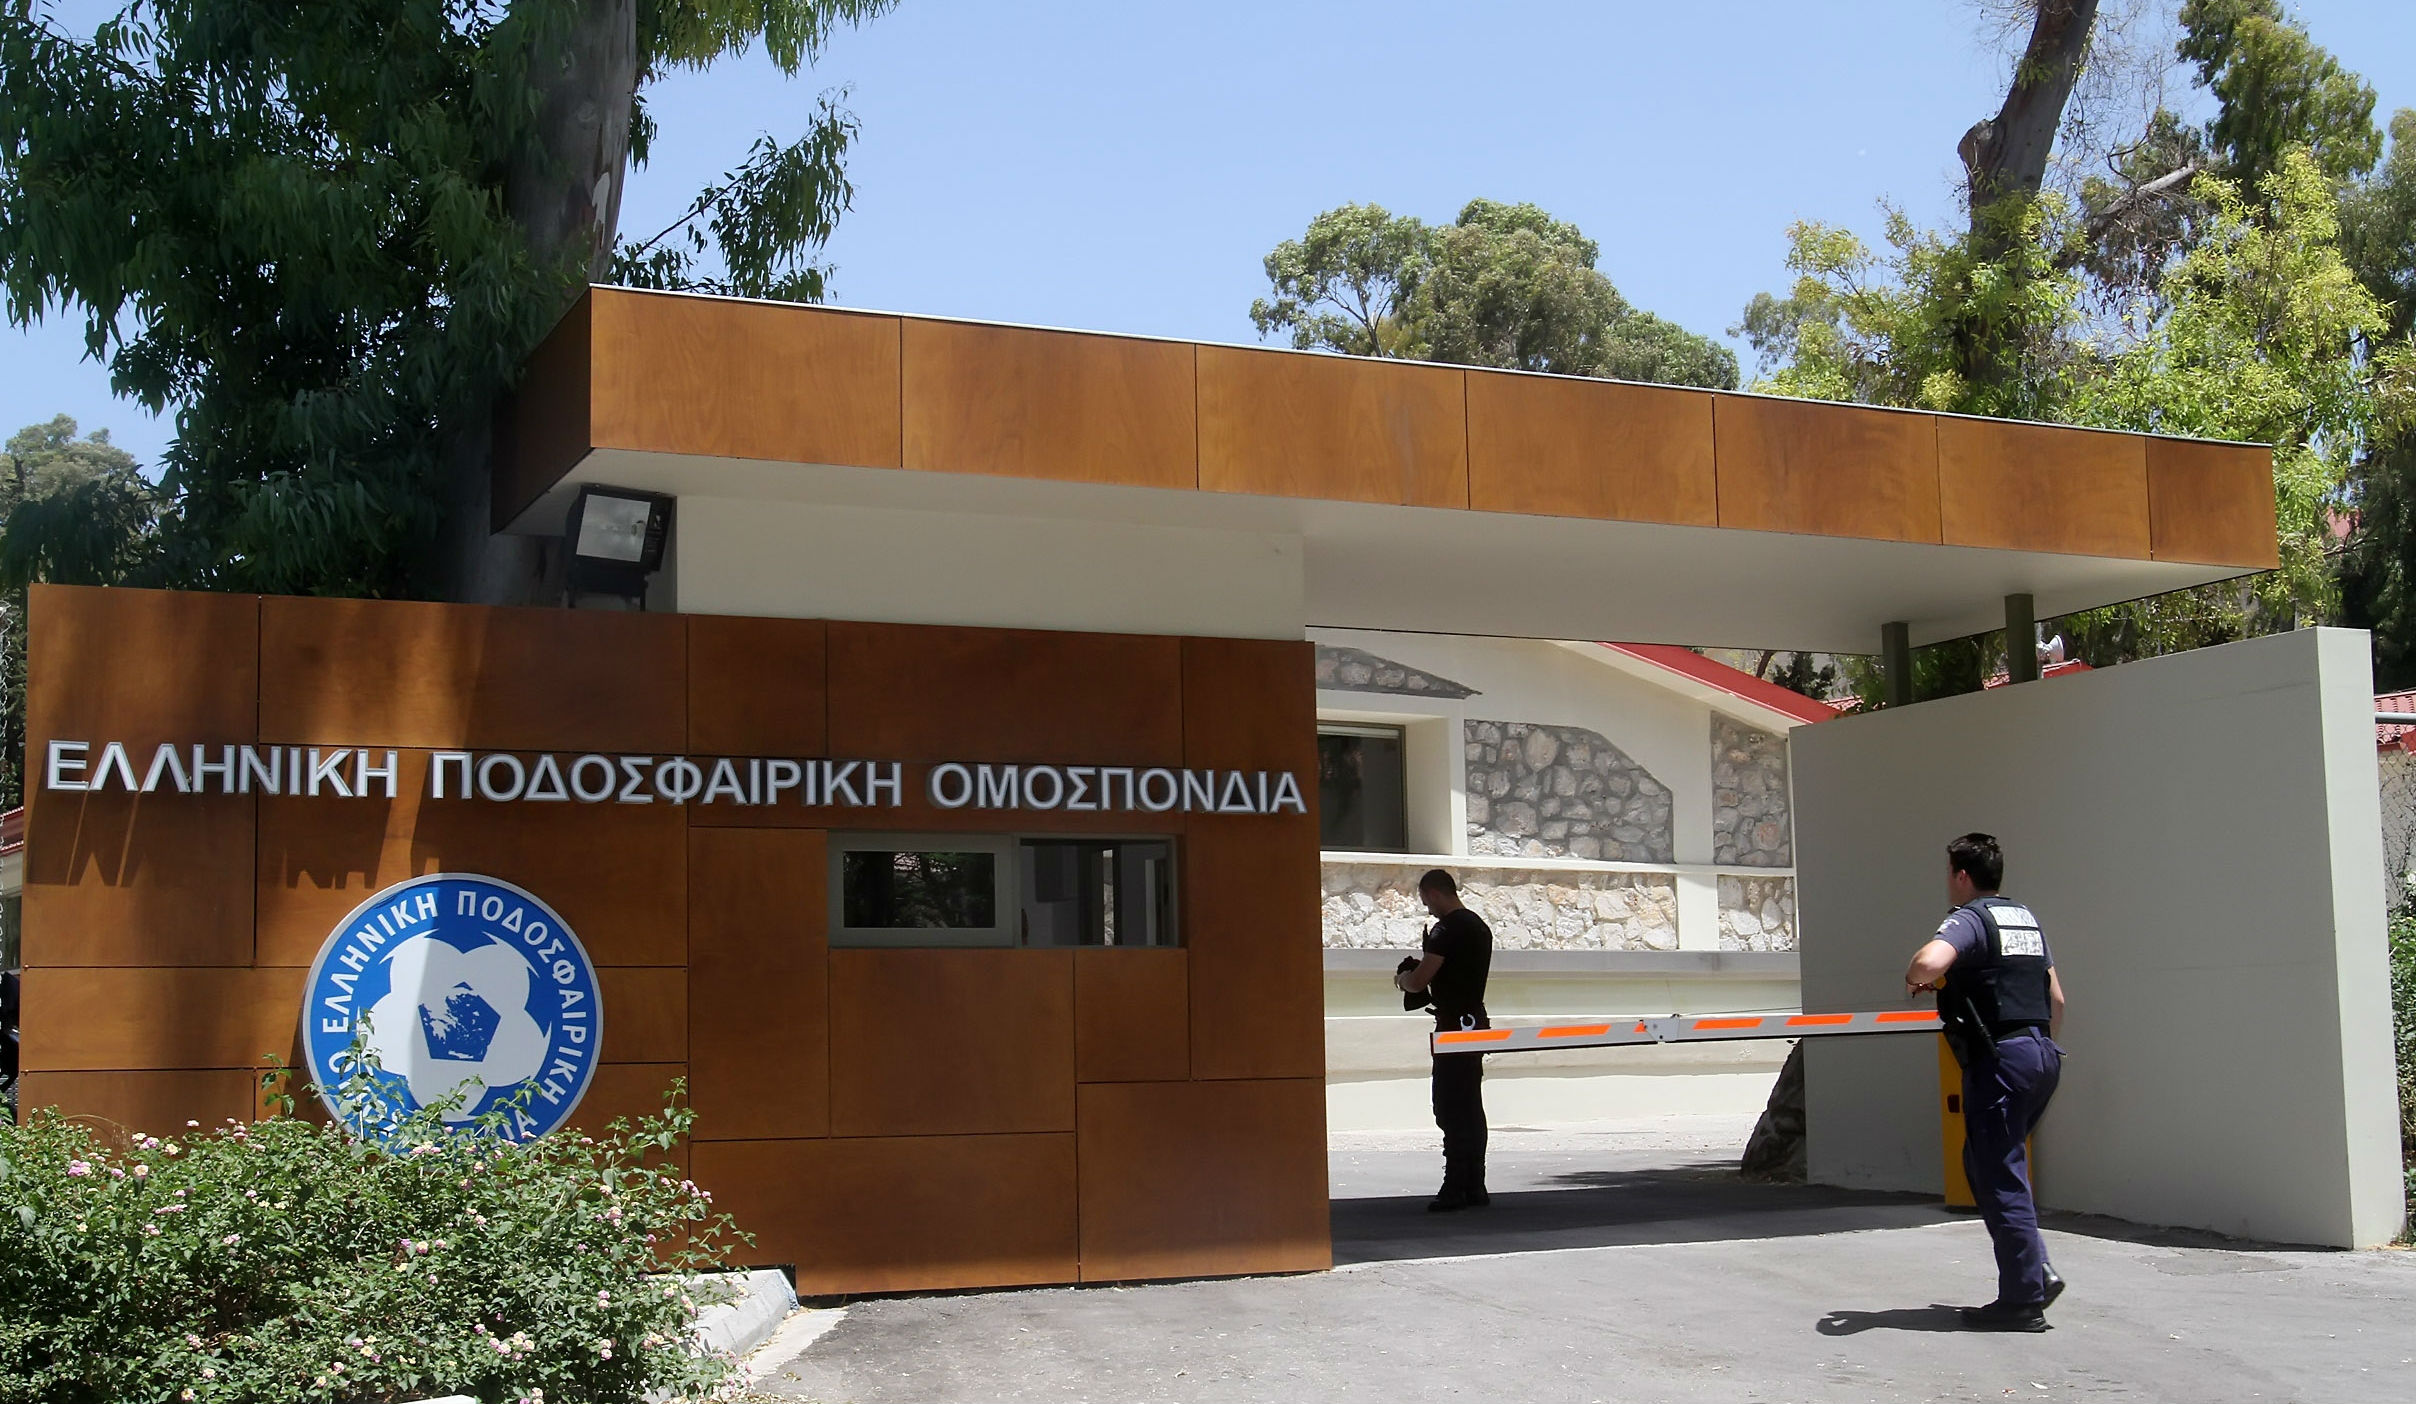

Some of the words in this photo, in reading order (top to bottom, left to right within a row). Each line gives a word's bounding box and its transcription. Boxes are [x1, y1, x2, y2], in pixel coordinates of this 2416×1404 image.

[47, 739, 398, 798] ΕΛΛΗΝΙΚΗ
[430, 750, 902, 807] ΠΟΔΟΣΦΑΙΡΙΚΗ
[931, 762, 1307, 814] ΟΜΟΣΠΟΝΔΙΑ
[322, 892, 438, 1033] ΕΛΛΗΝΙΚΗ
[457, 890, 587, 1106] ΠΟΔΟΣΦΑΙΡΙΚΗ
